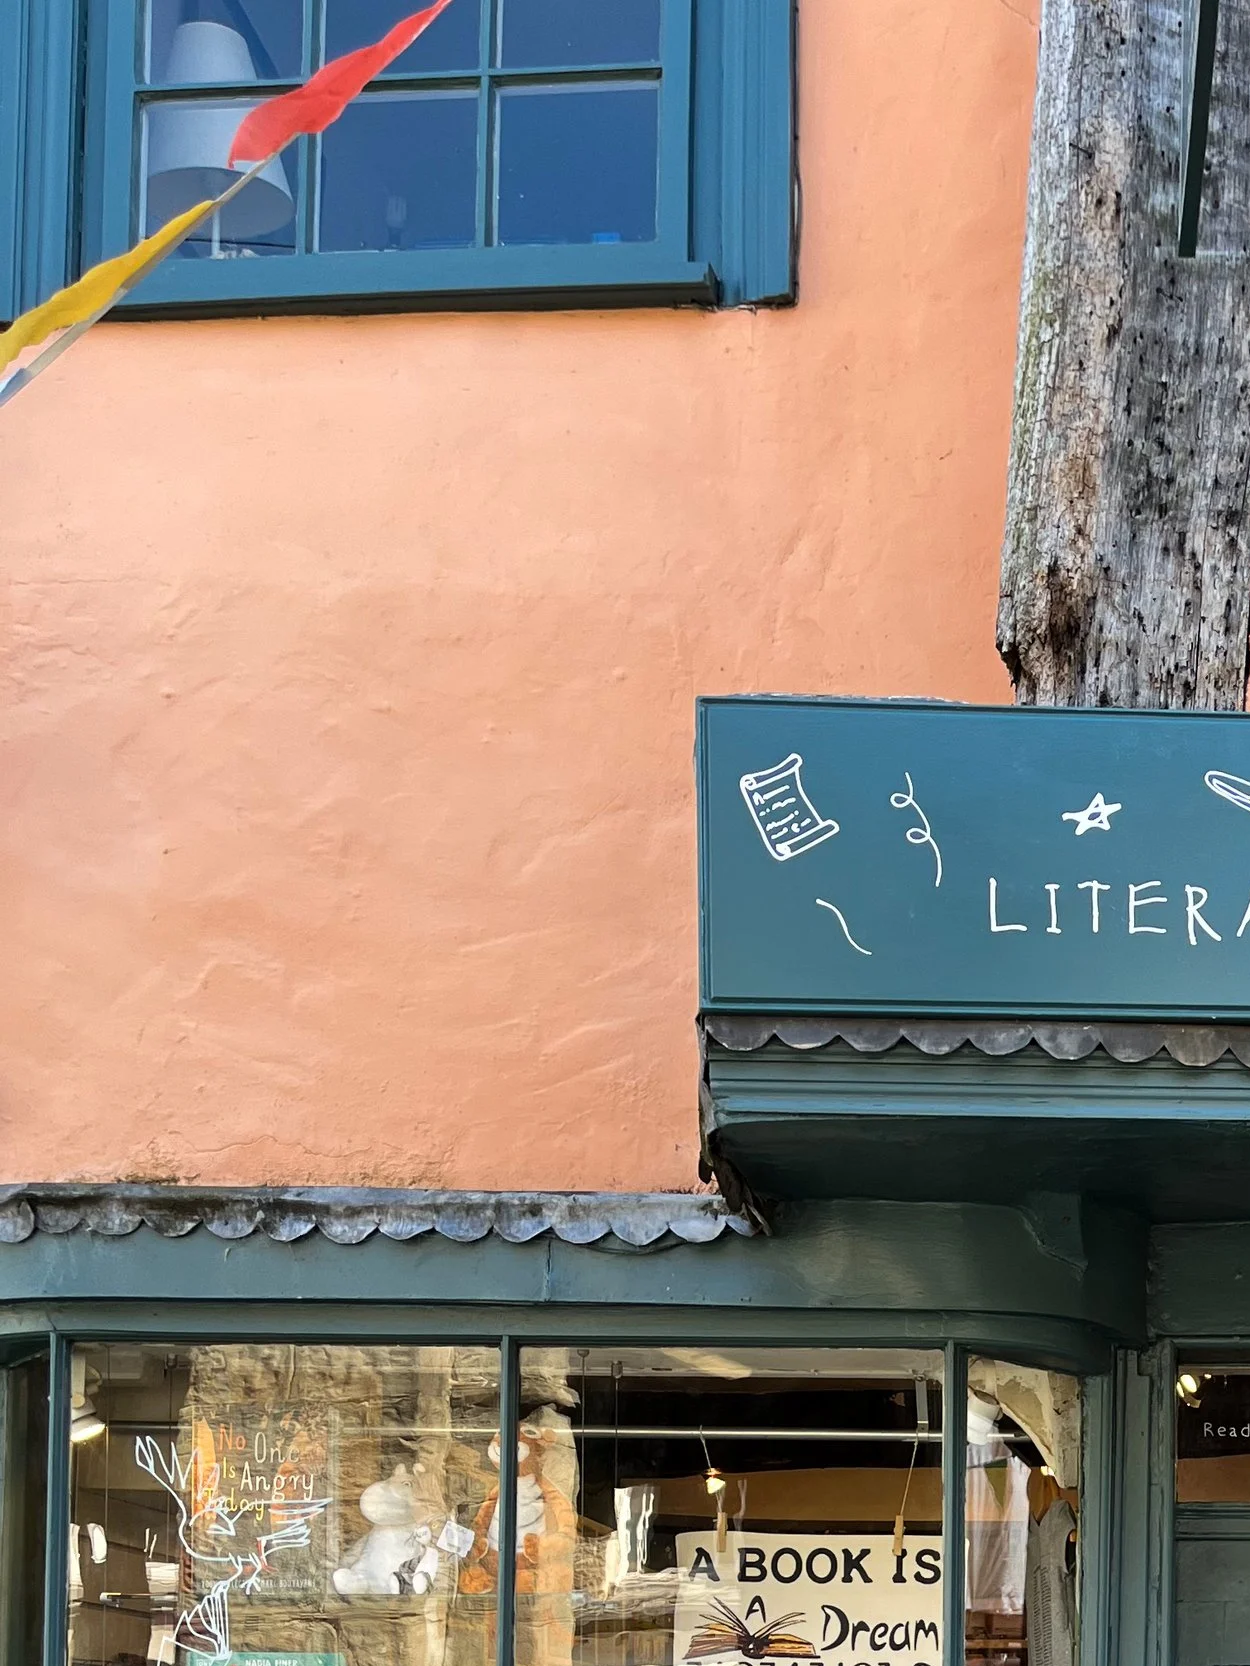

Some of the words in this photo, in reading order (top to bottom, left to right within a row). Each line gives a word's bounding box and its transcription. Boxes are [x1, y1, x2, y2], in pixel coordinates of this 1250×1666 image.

[219, 1423, 247, 1451] No
[254, 1432, 300, 1463] One
[1203, 1422, 1250, 1438] Read
[222, 1456, 236, 1479] Is
[240, 1461, 314, 1501] Angry
[688, 1546, 721, 1582] A
[737, 1547, 873, 1584] BOOK
[892, 1548, 942, 1584] IS
[745, 1595, 767, 1624] A
[820, 1604, 940, 1652] Dream
